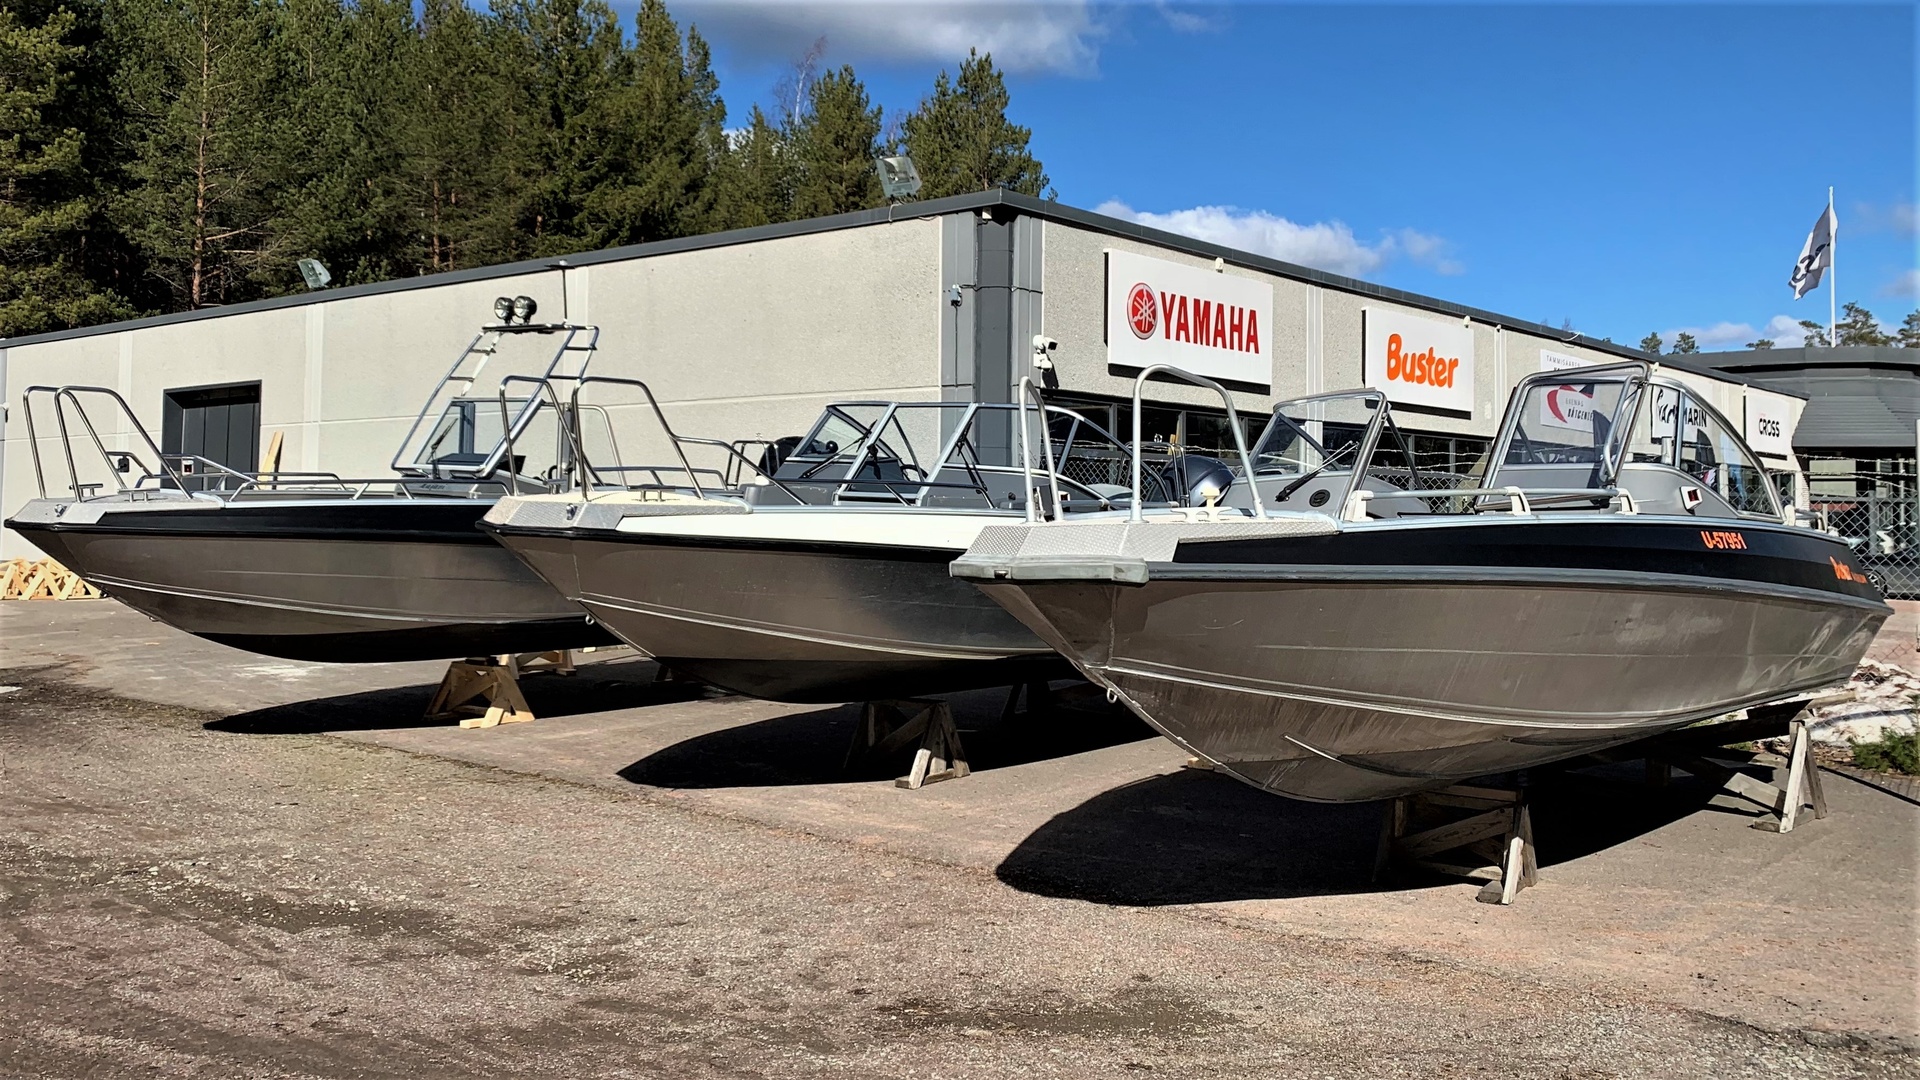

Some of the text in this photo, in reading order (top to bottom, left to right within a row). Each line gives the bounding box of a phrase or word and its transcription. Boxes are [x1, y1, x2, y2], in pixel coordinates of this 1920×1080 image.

[1160, 291, 1260, 355] YAMAHA
[1386, 333, 1459, 389] Buster
[1758, 417, 1780, 438] CROSS
[1700, 530, 1748, 550] U-57951
